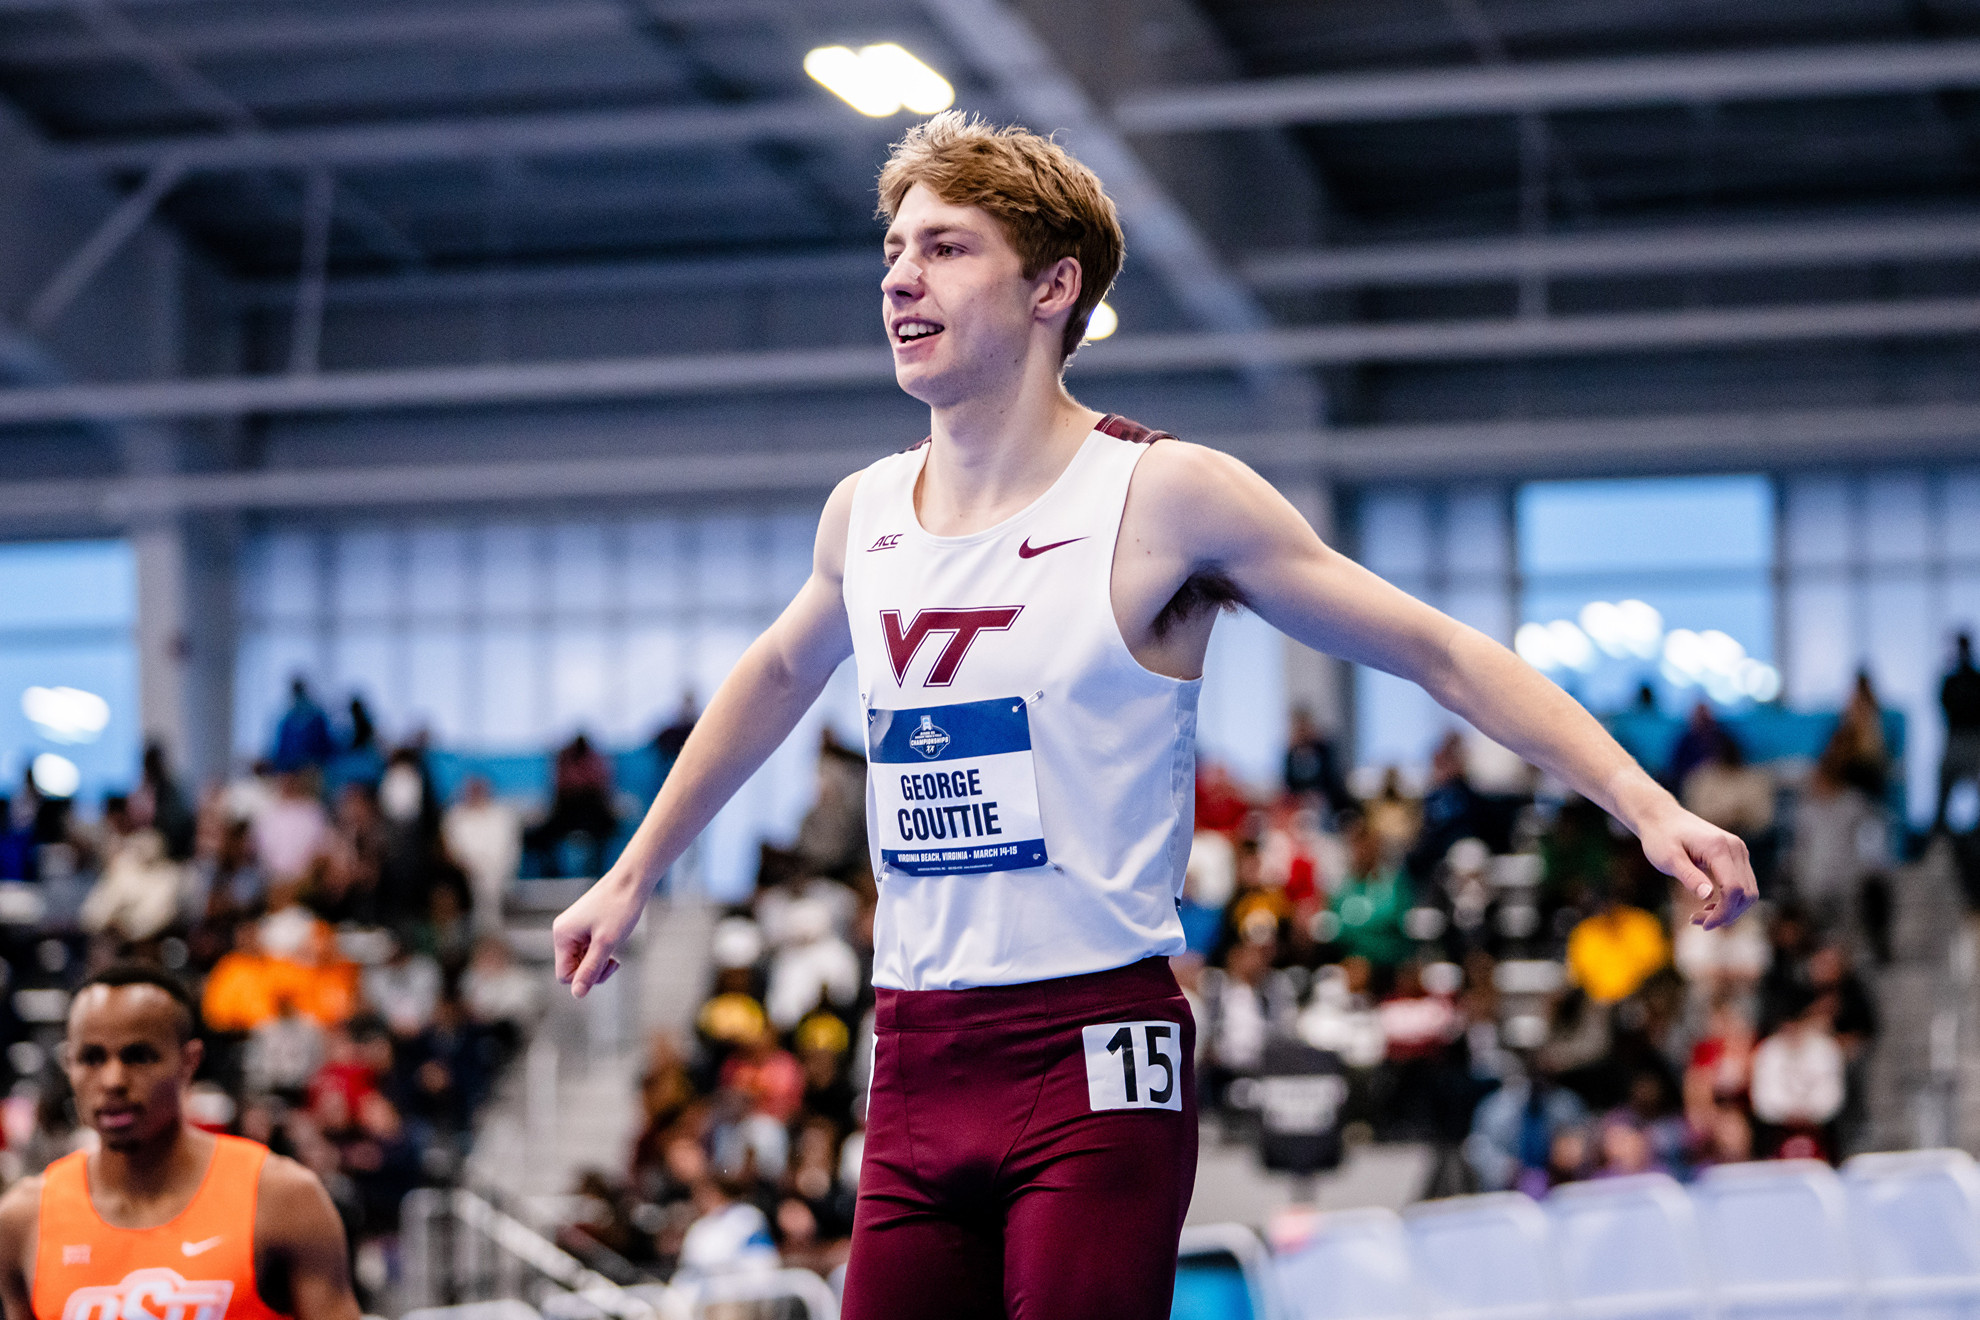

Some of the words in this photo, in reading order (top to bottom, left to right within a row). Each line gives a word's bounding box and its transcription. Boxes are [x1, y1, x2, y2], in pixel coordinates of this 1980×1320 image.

[870, 533, 904, 549] ACC
[879, 604, 1026, 689] VT
[900, 769, 983, 801] GEORGE
[897, 802, 1002, 841] COUTTIE
[897, 853, 920, 863] VIRGINIA
[920, 852, 941, 863] BEACH,
[942, 851, 968, 862] VIRGINIA
[973, 848, 998, 860] MARCH
[999, 846, 1018, 857] 14-15
[1105, 1025, 1174, 1104] 15
